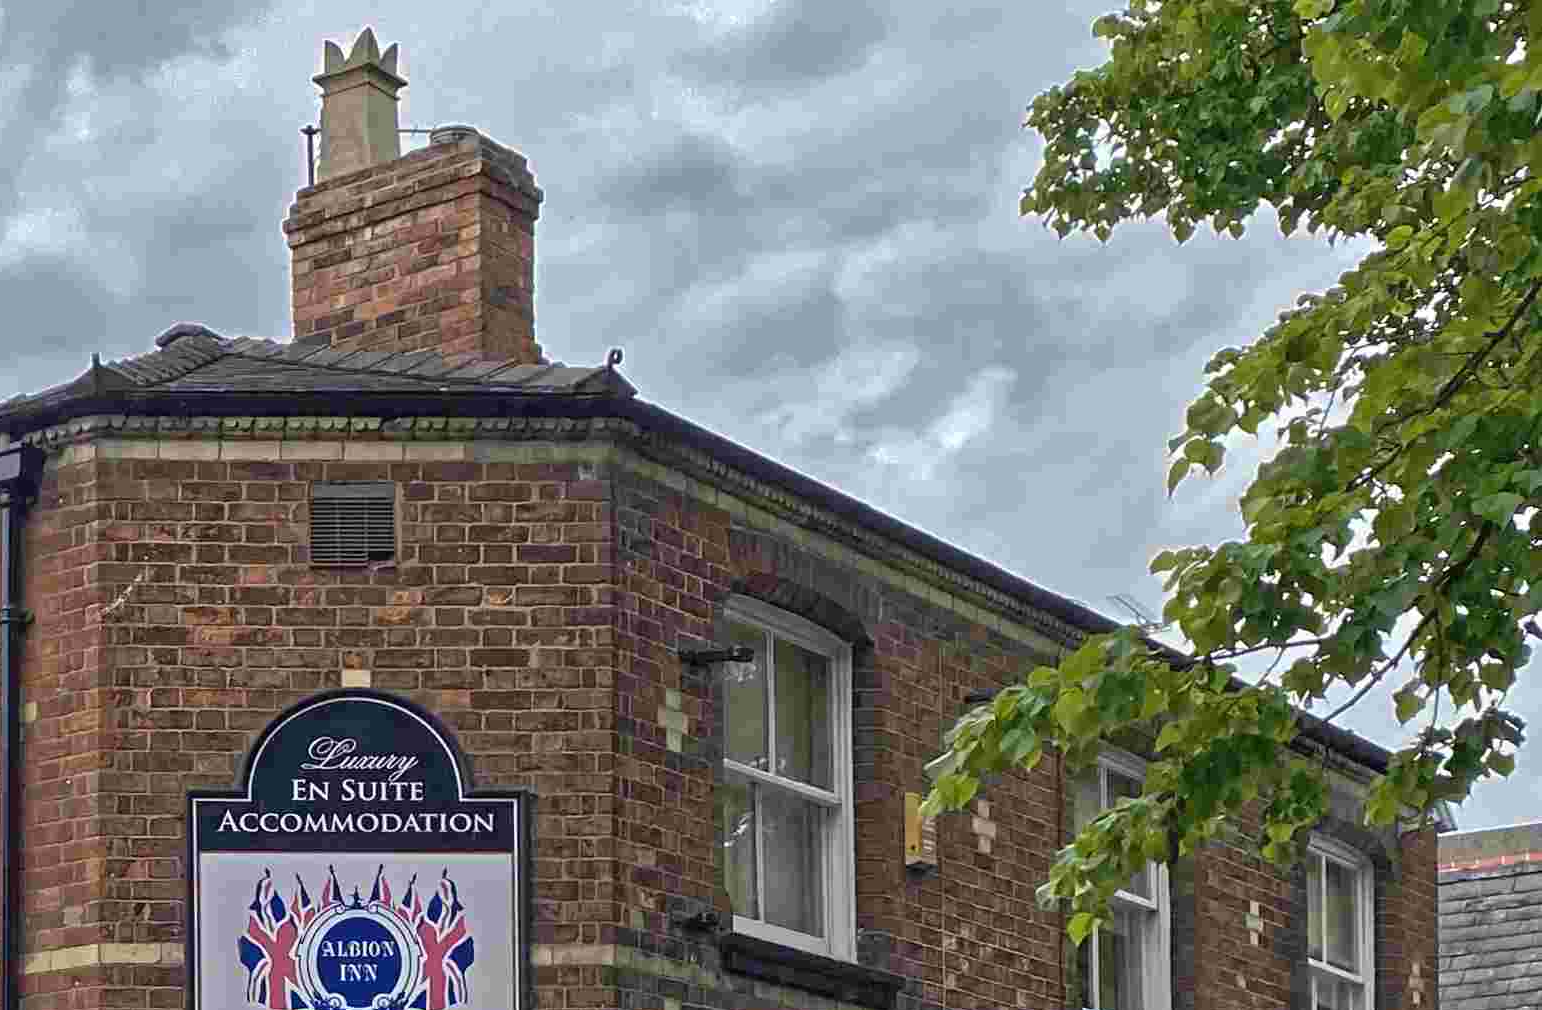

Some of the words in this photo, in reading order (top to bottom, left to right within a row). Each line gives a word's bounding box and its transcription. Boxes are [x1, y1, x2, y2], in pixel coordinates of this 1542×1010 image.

[300, 736, 419, 782] Luxury
[291, 778, 329, 801] EN
[341, 778, 425, 802] SUITE
[217, 809, 495, 833] ACCOMMODATION
[321, 939, 395, 959] ALBION
[339, 962, 379, 983] INN
